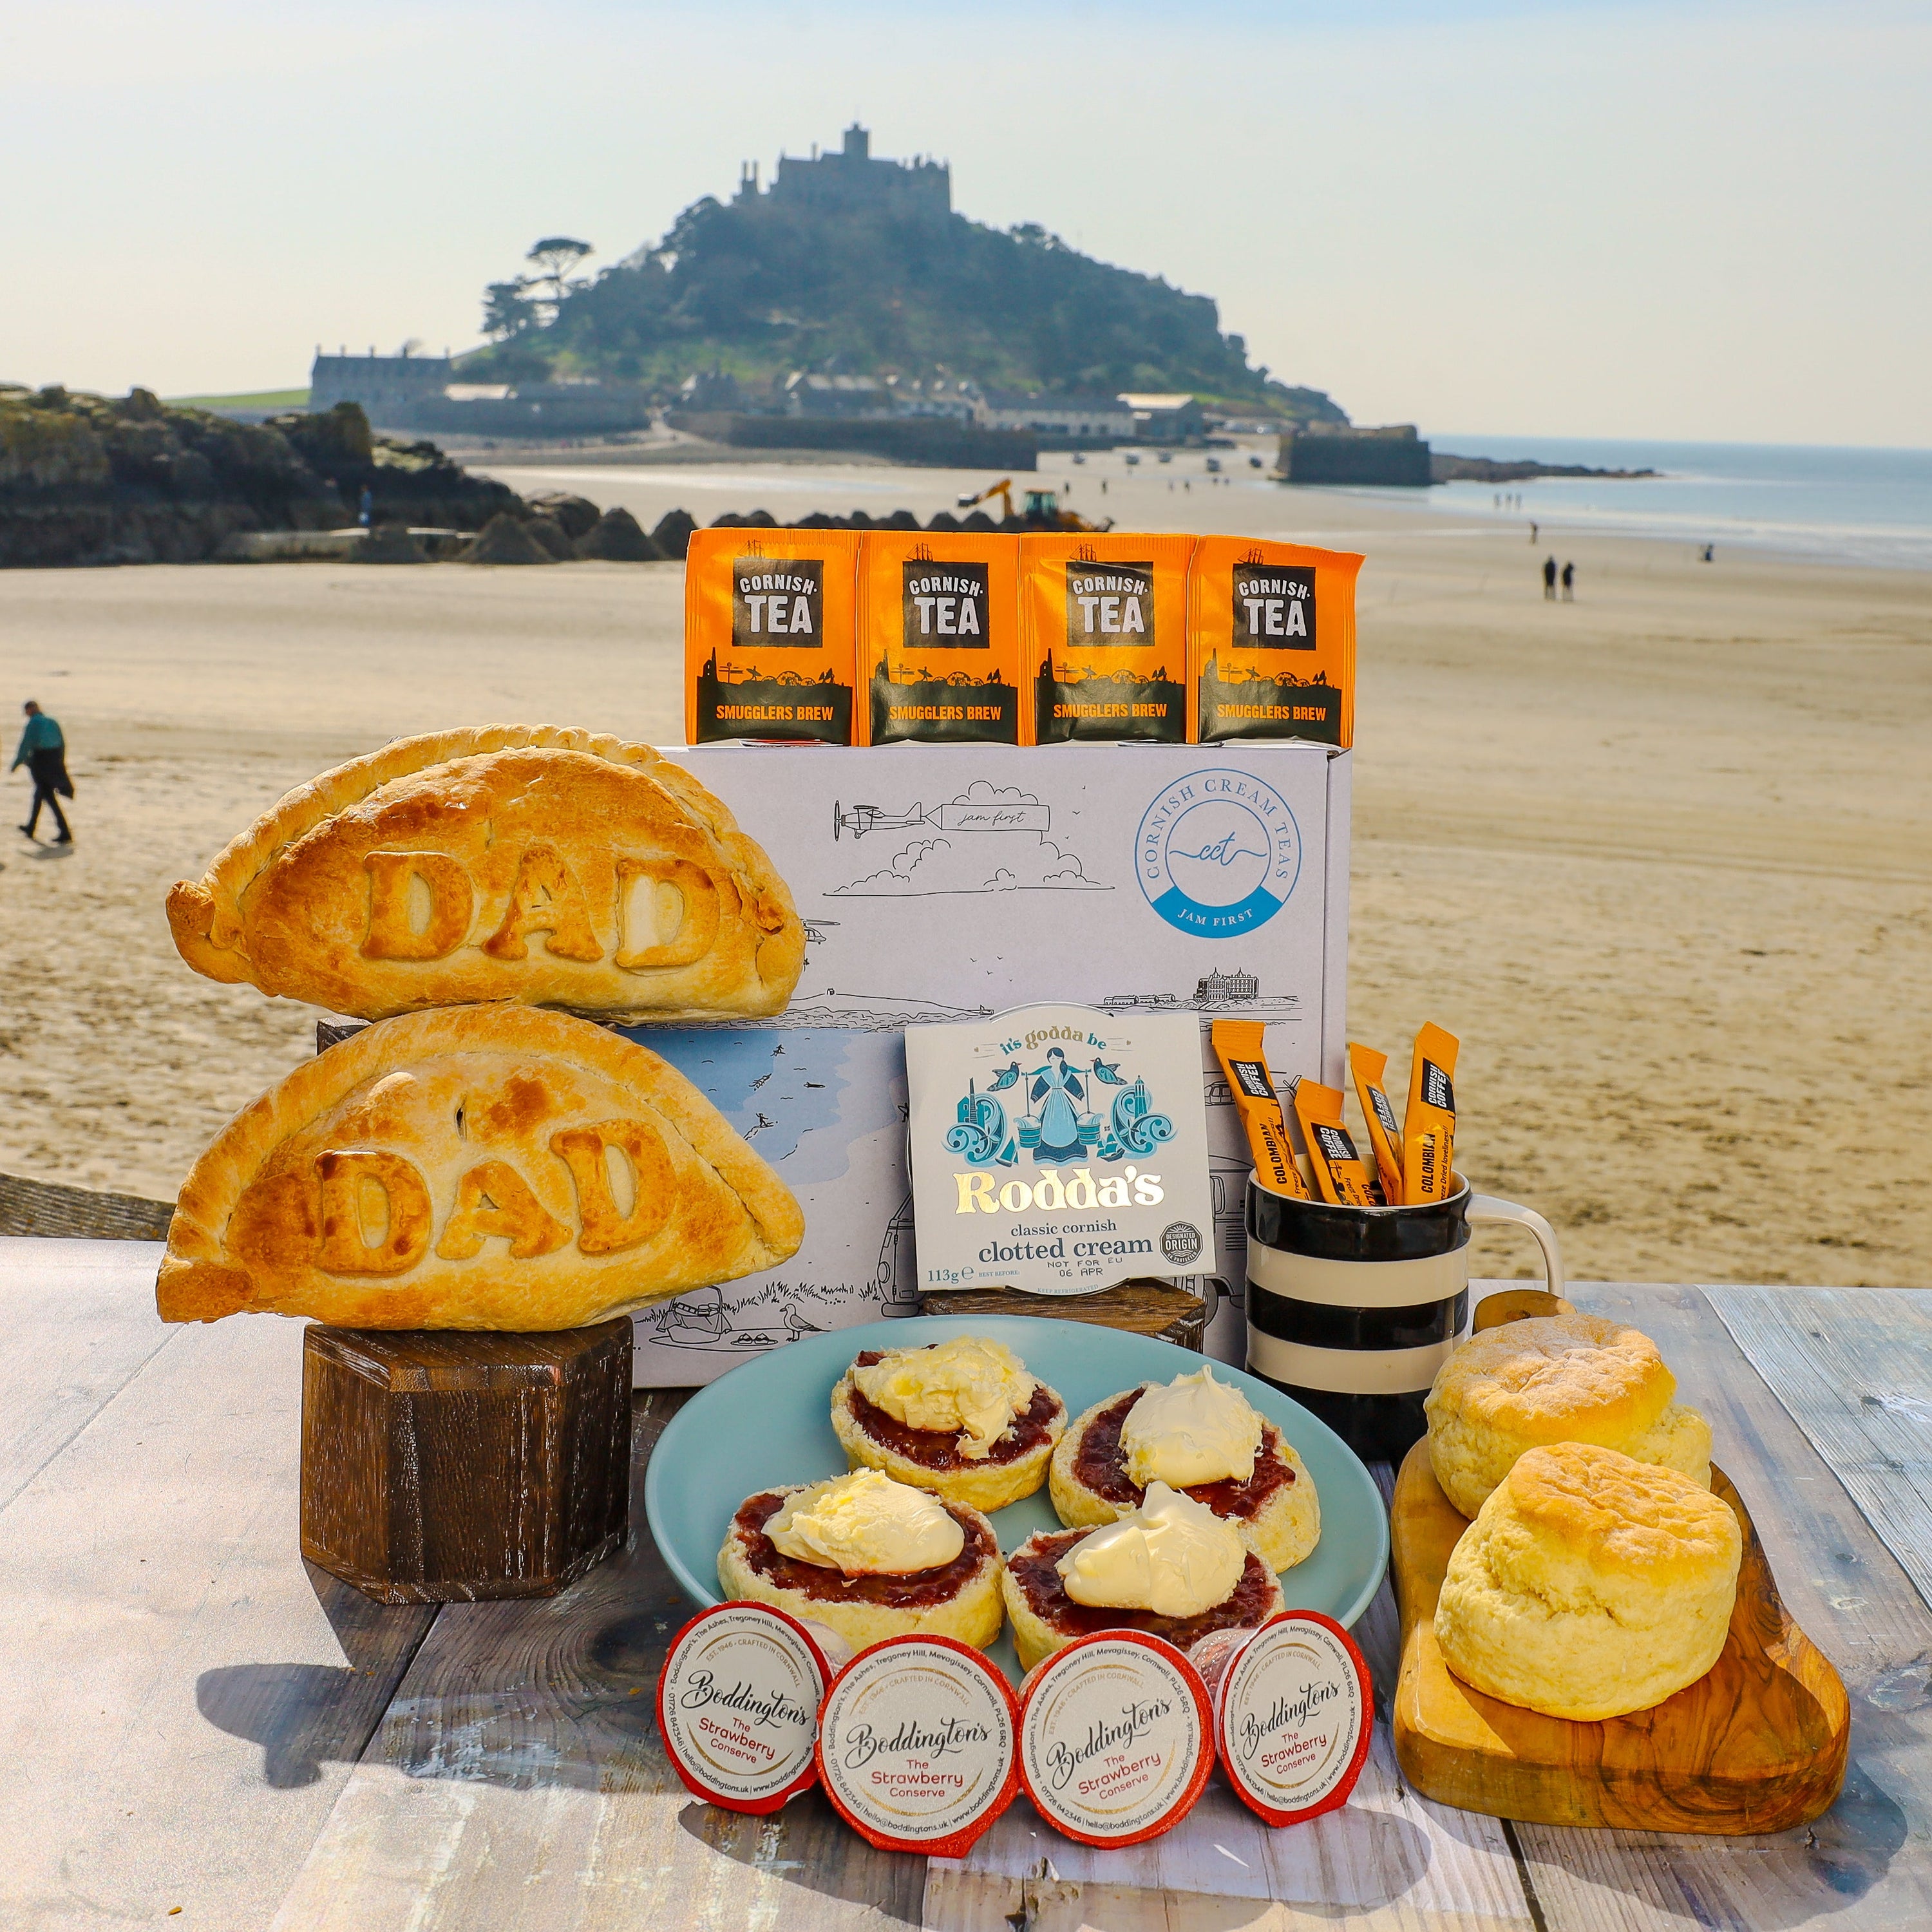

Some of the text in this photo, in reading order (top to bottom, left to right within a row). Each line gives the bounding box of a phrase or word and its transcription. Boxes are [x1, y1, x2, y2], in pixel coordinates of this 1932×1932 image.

[744, 595, 813, 633] TEA
[914, 596, 980, 634] TEA
[1077, 596, 1144, 633] TEA
[1243, 599, 1307, 637] TEA
[716, 705, 833, 721] SMUGGLERS BREW
[889, 706, 1001, 721] SMUGGLERS BREW
[1053, 703, 1167, 718] SMUGGLERS BREW
[1217, 705, 1326, 721] SMUGGLERS BREW
[958, 810, 1027, 826] jam first
[1144, 779, 1291, 880] CORNISH CREAM TEAS
[361, 846, 721, 969] DAD
[1177, 908, 1254, 927] JAM FIRST
[999, 1025, 1108, 1056] it's godda be
[1236, 1063, 1260, 1095] CORNISH
[1245, 1063, 1269, 1096] COFFEE
[1428, 1064, 1438, 1104] CORNISH
[1436, 1068, 1447, 1108] COFFEE
[1372, 1090, 1390, 1128] COFFEE
[1259, 1123, 1287, 1184] COLOMBIAN
[1320, 1127, 1343, 1159] COFFEE
[313, 1119, 677, 1278] DAD
[953, 1165, 1164, 1215] Rodda's
[1361, 1184, 1376, 1206] COLO
[1010, 1219, 1117, 1237] classic cornish
[1165, 1238, 1197, 1251] ORIGIN
[978, 1238, 1153, 1263] clotted cream
[927, 1269, 960, 1284] 113g
[1059, 1267, 1104, 1278] 06 APR
[695, 1628, 708, 1638] The
[738, 1639, 768, 1649] CRAFTED
[776, 1651, 800, 1689] CORNWALL
[1262, 1651, 1285, 1672] CRAFTED
[1293, 1651, 1321, 1671] CORNWALL
[842, 1681, 855, 1695] The
[854, 1664, 876, 1683] Ashes,
[875, 1651, 911, 1666] Tregoney
[913, 1649, 927, 1658] Hill,
[929, 1651, 972, 1677] Mevagissey,
[974, 1674, 998, 1708] Cornwall,
[994, 1708, 1006, 1728] PL26
[1031, 1707, 1040, 1721] The
[1051, 1657, 1081, 1683] Tregoney
[1097, 1647, 1140, 1660] Mevagissey,
[1142, 1654, 1171, 1680] Cornwall,
[1169, 1676, 1184, 1696] PL26
[1180, 1696, 1190, 1714] 6RQ
[1066, 1674, 1096, 1698] CRAFTED
[1340, 1662, 1351, 1680] PL26
[1347, 1680, 1355, 1699] 6RQ
[681, 1670, 811, 1728] Boddington's
[732, 1717, 751, 1732] The
[1240, 1681, 1341, 1760] Boddington's
[699, 1718, 775, 1761] Strawberry
[710, 1738, 757, 1763] Conserve
[845, 1717, 992, 1770] Boddington's
[1046, 1697, 1172, 1790] Boddington's
[1261, 1734, 1327, 1768] Strawberry
[1282, 1732, 1299, 1744] The
[1327, 1705, 1356, 1781] www.boddingtons.uk
[681, 1748, 749, 1794] hello@boddingtons.uk
[753, 1745, 812, 1792] www.boddingtons.uk
[906, 1759, 929, 1770] The
[1041, 1785, 1057, 1806] 01726
[1085, 1801, 1164, 1831] hello@boddingtons.uk
[1164, 1721, 1194, 1801] www.boddingtons.uk
[1078, 1752, 1161, 1795] Strawberry
[1103, 1754, 1125, 1768] The
[1276, 1753, 1316, 1774] Conserve
[871, 1770, 963, 1787] Strawberry
[890, 1789, 945, 1797] Conserve
[1099, 1774, 1149, 1800] Conserve
[831, 1757, 1005, 1834] 01726 842346 hello@boddingtons.uk www.boddingtons.uk
